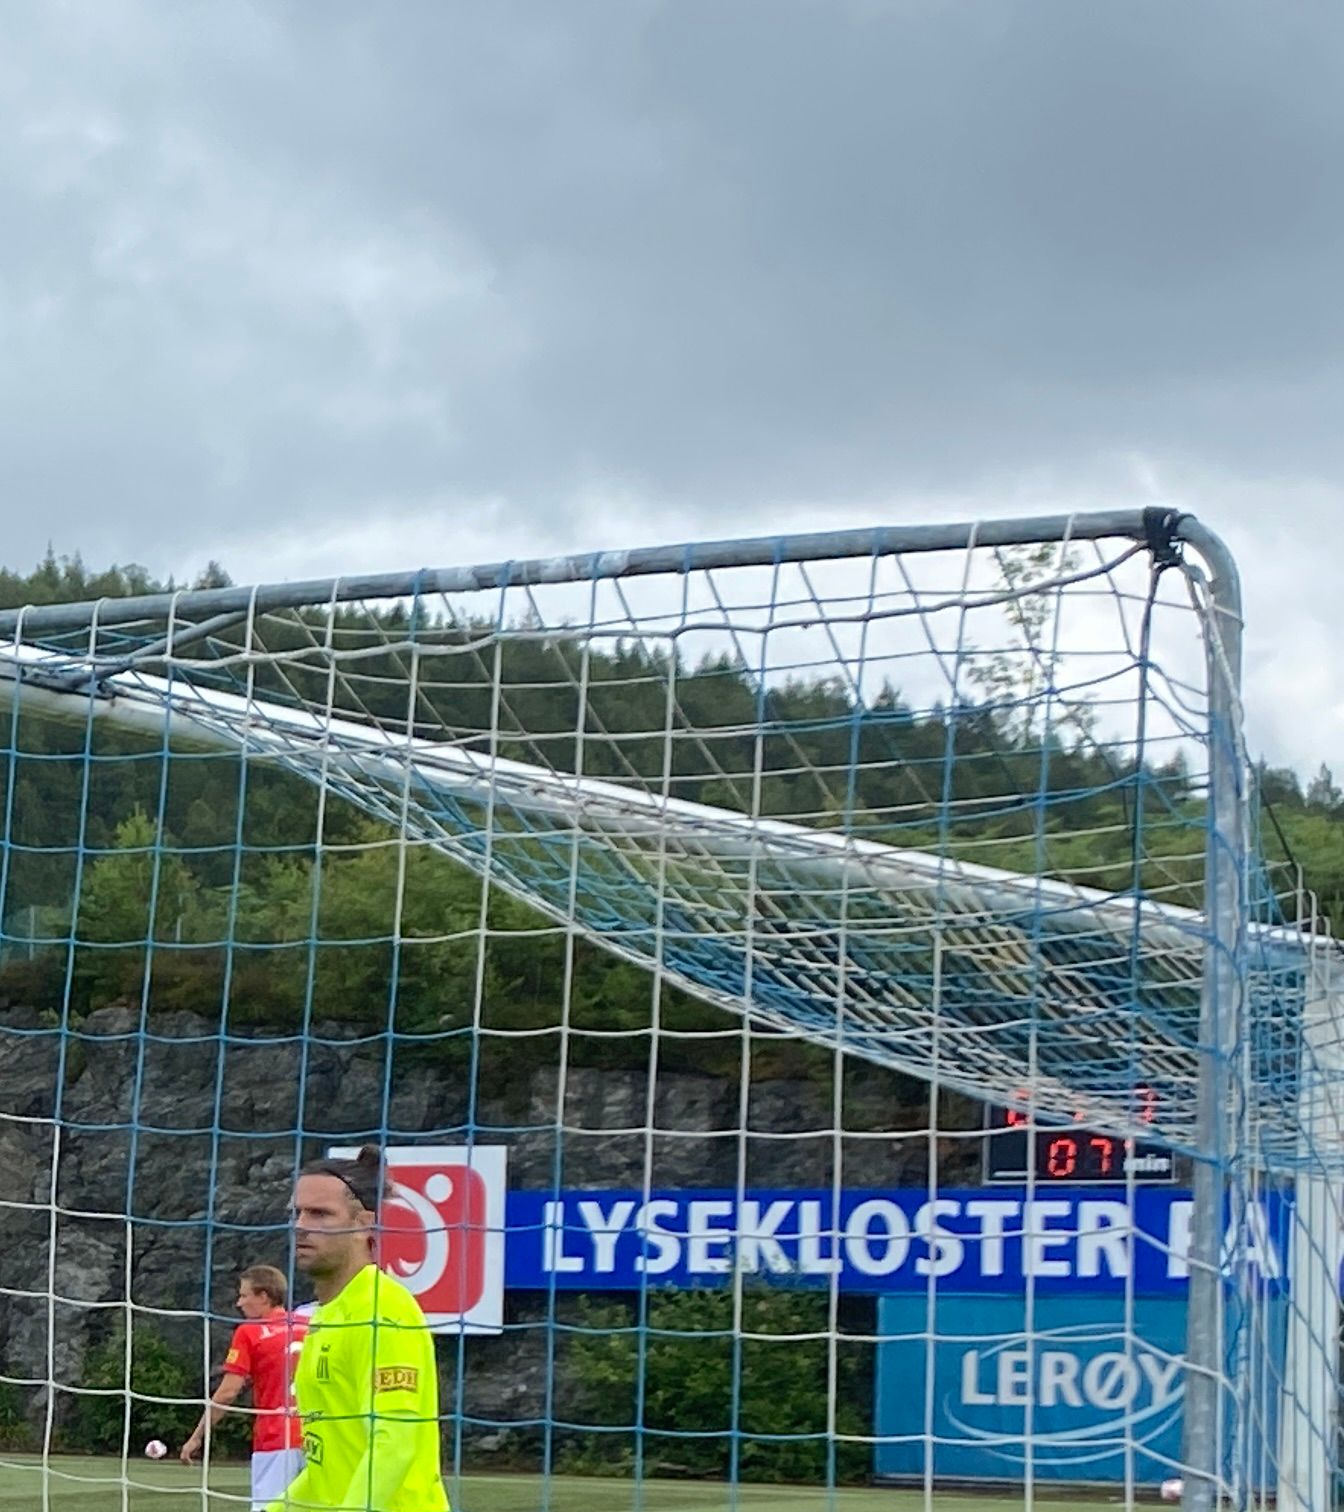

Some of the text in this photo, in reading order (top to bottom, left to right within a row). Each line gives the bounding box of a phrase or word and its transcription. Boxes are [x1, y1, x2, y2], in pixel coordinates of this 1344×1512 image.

[542, 1199, 1297, 1280] LYSEKLOSTER FA
[962, 1349, 1187, 1410] LERØY
